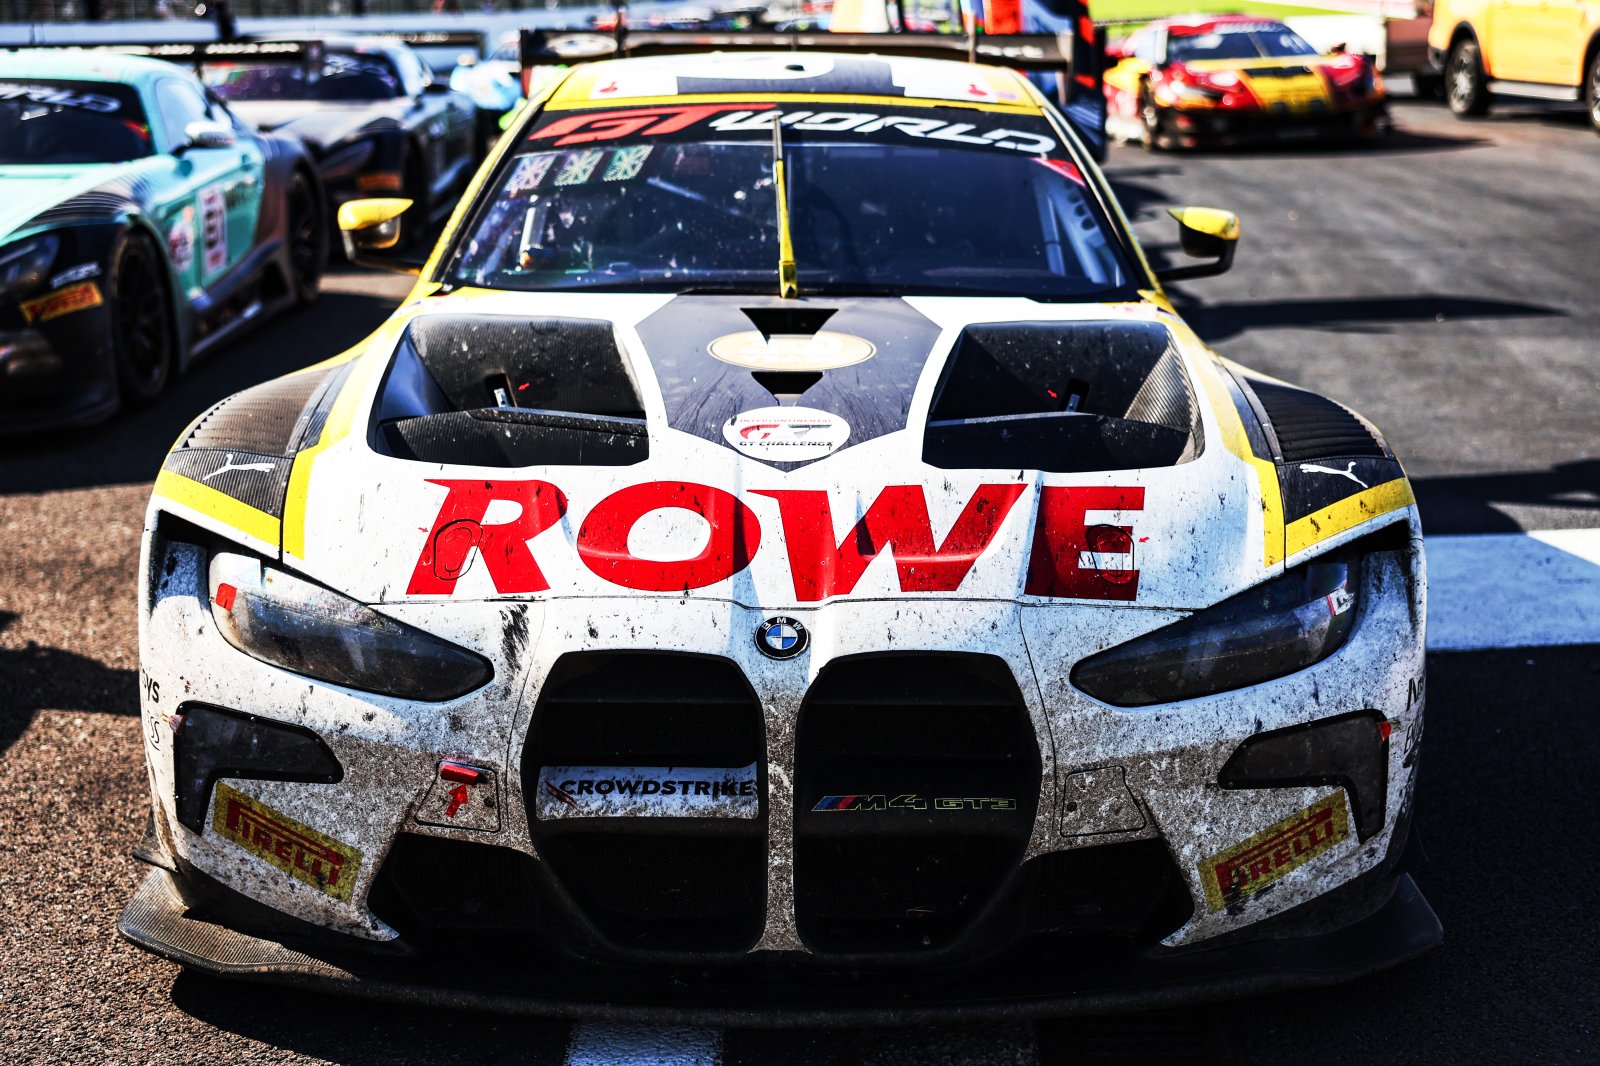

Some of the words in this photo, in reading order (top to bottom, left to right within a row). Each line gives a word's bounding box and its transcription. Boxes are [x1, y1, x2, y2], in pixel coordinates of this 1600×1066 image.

[528, 103, 778, 146] GT
[708, 110, 1056, 154] WORLD
[406, 478, 1145, 601] ROWE
[761, 617, 804, 631] BMW
[559, 780, 756, 796] CROWDSTRIKE
[934, 798, 1017, 810] GT3
[225, 798, 346, 887] PIRELLI
[1215, 806, 1334, 899] PIRELLI
